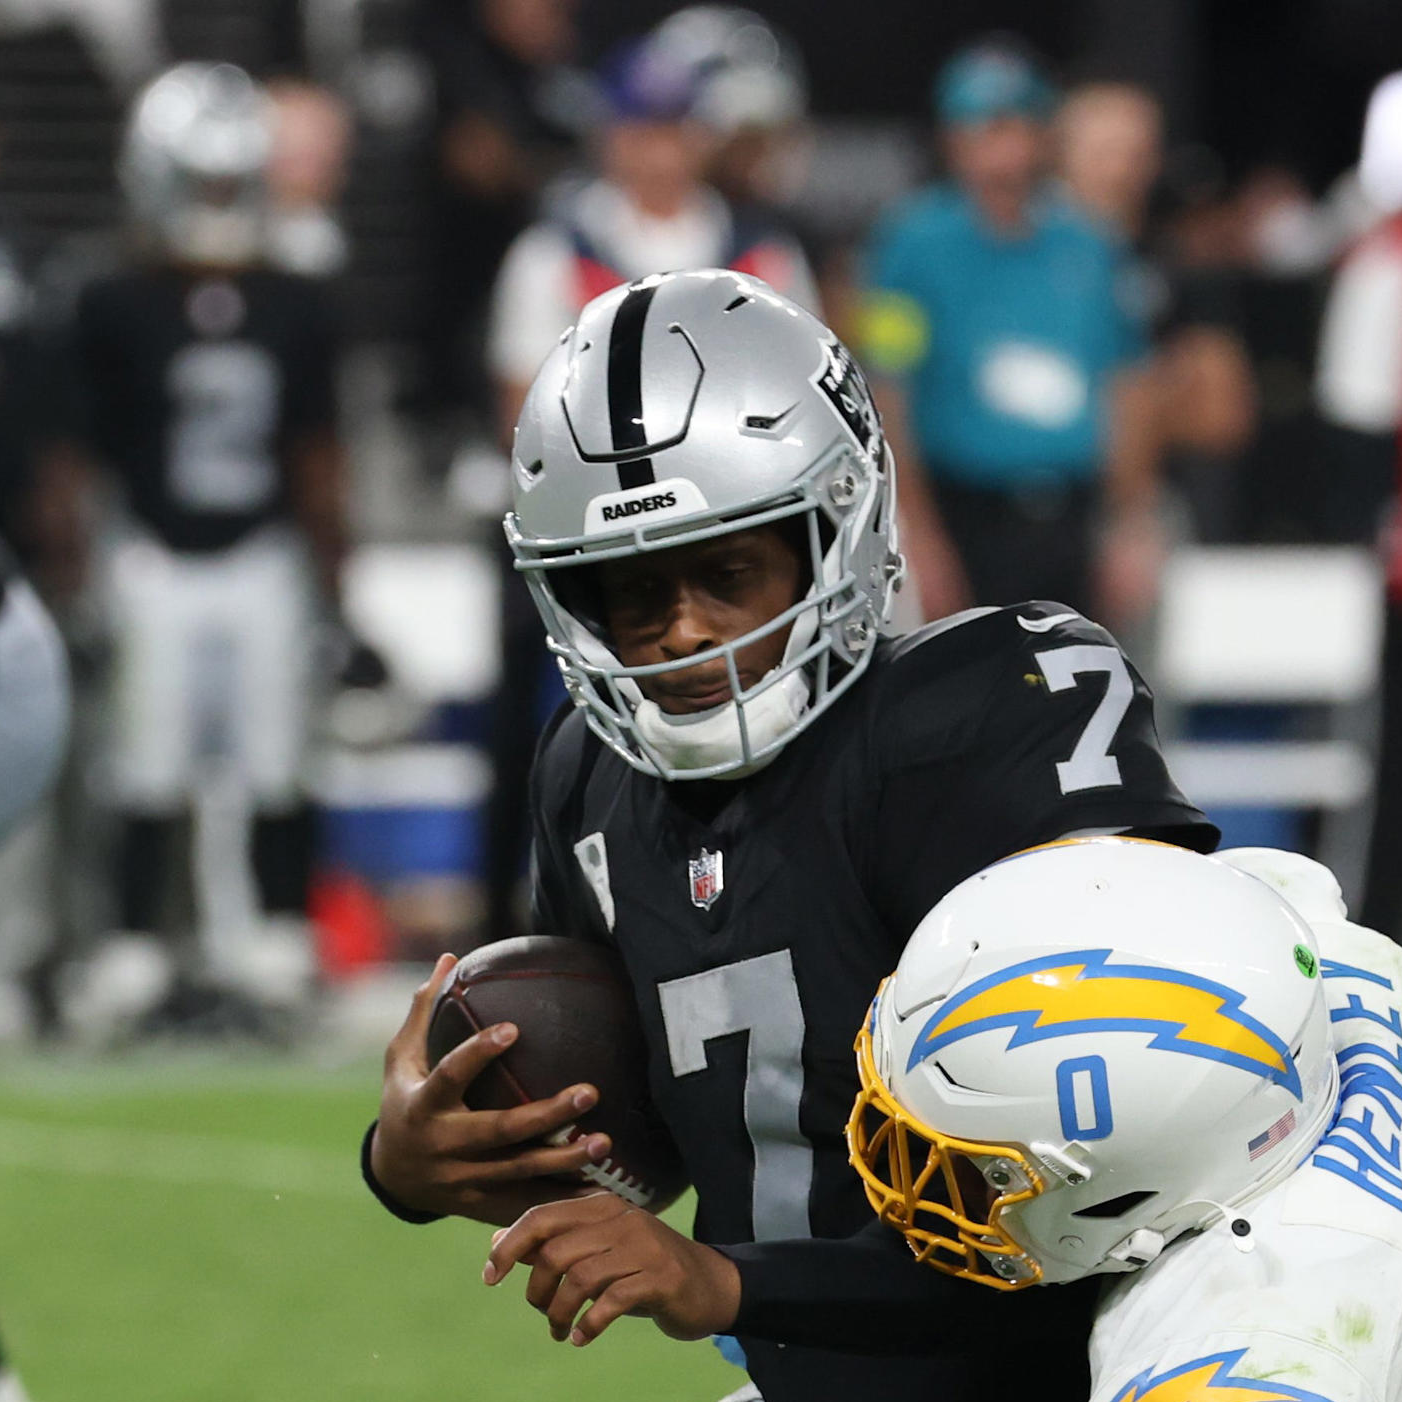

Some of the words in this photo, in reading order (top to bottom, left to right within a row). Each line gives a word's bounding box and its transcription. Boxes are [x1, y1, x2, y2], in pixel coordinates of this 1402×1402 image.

[602, 491, 677, 521] RAIDERS
[1034, 644, 1134, 796] 7
[657, 948, 813, 1242] 7
[1056, 1054, 1114, 1141] 0
